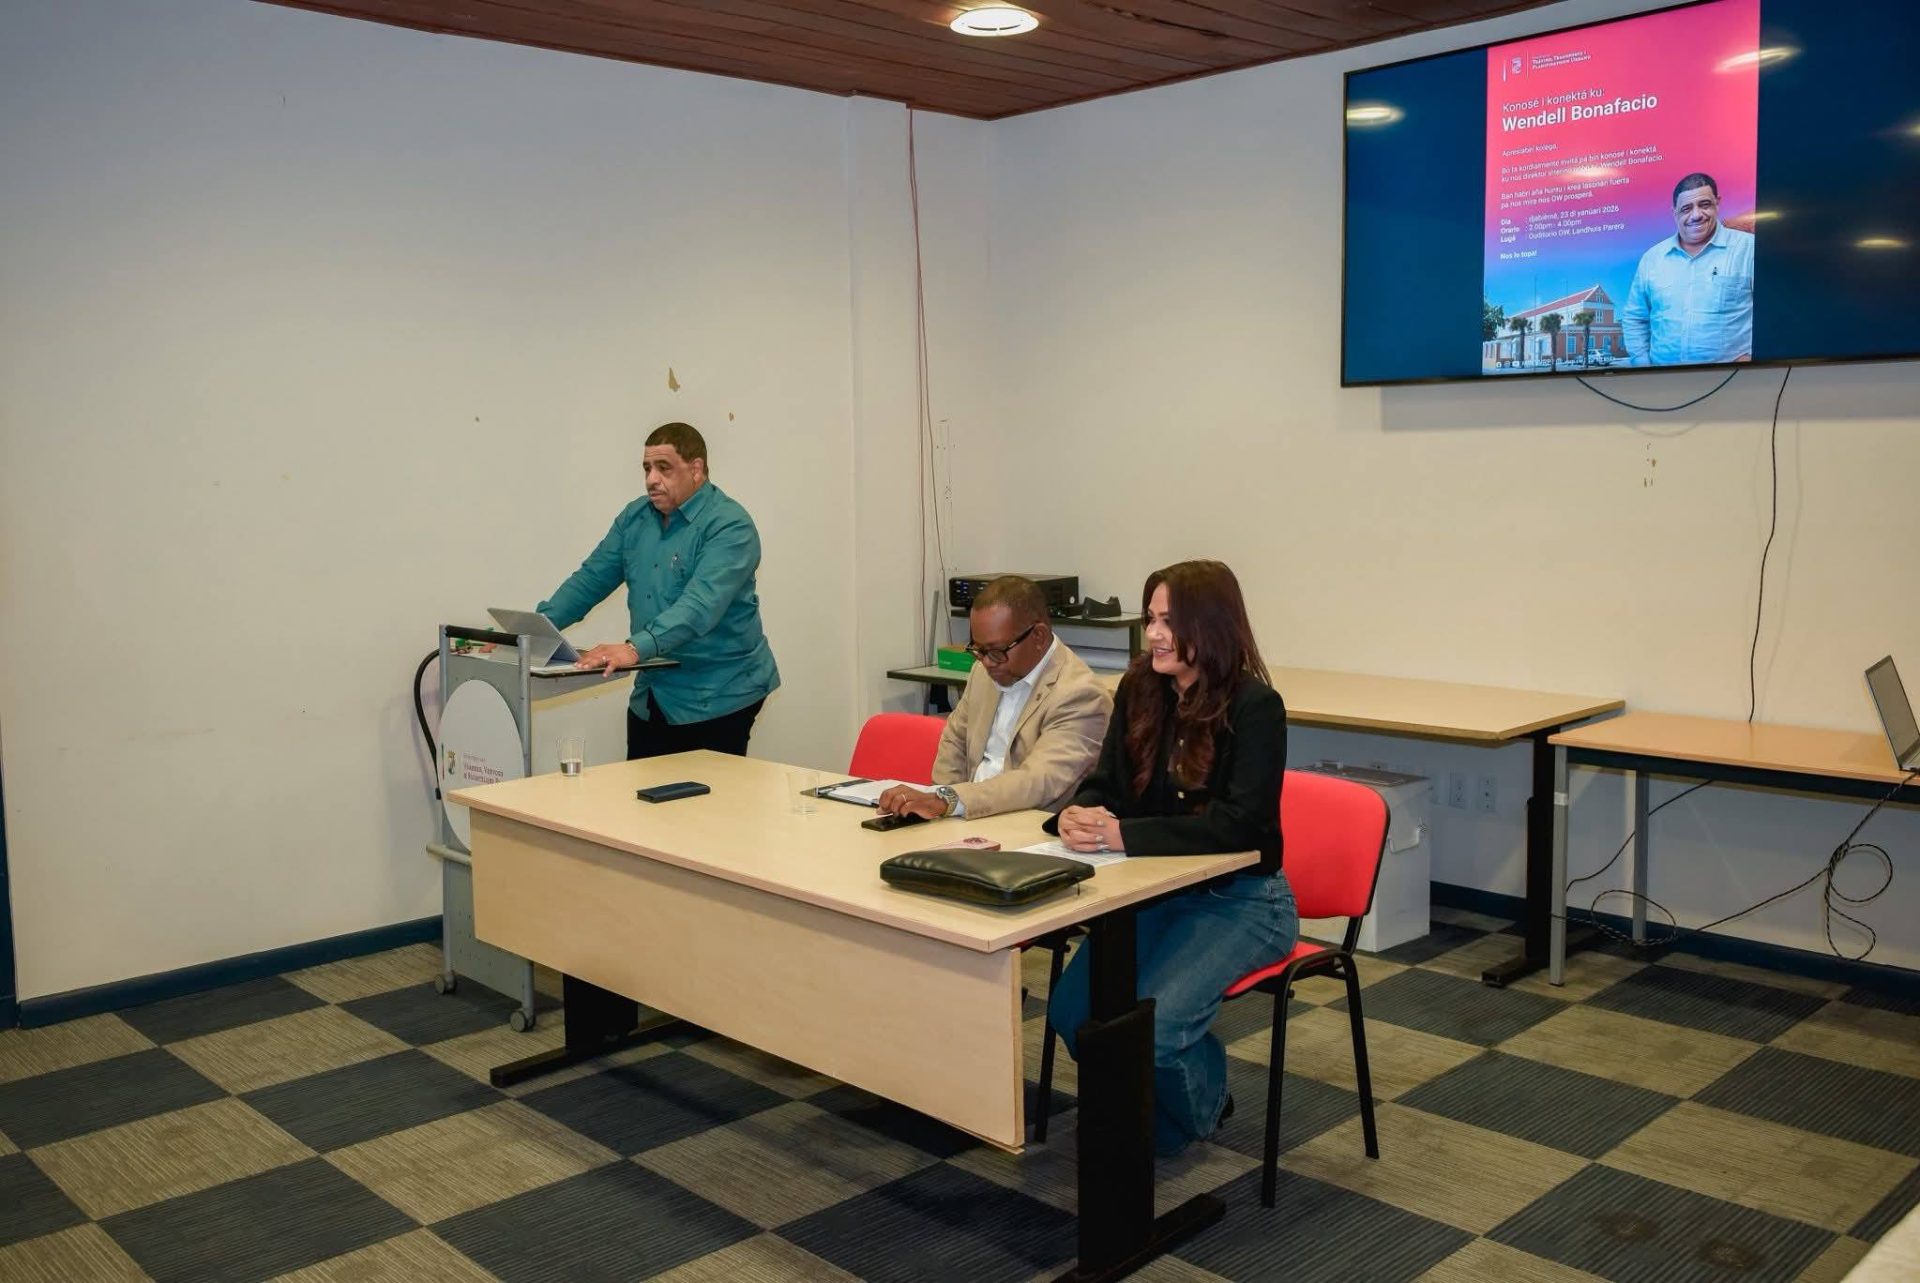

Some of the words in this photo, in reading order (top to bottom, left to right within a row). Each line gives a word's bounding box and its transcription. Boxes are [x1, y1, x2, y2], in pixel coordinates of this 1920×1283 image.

[1590, 87, 1605, 98] ku:
[1502, 106, 1566, 132] Wendell
[1571, 94, 1658, 121] Bonafacio
[1560, 210, 1569, 219] 23
[1602, 204, 1620, 214] 2026
[1602, 223, 1625, 232] Parera
[1500, 251, 1513, 260] Nos
